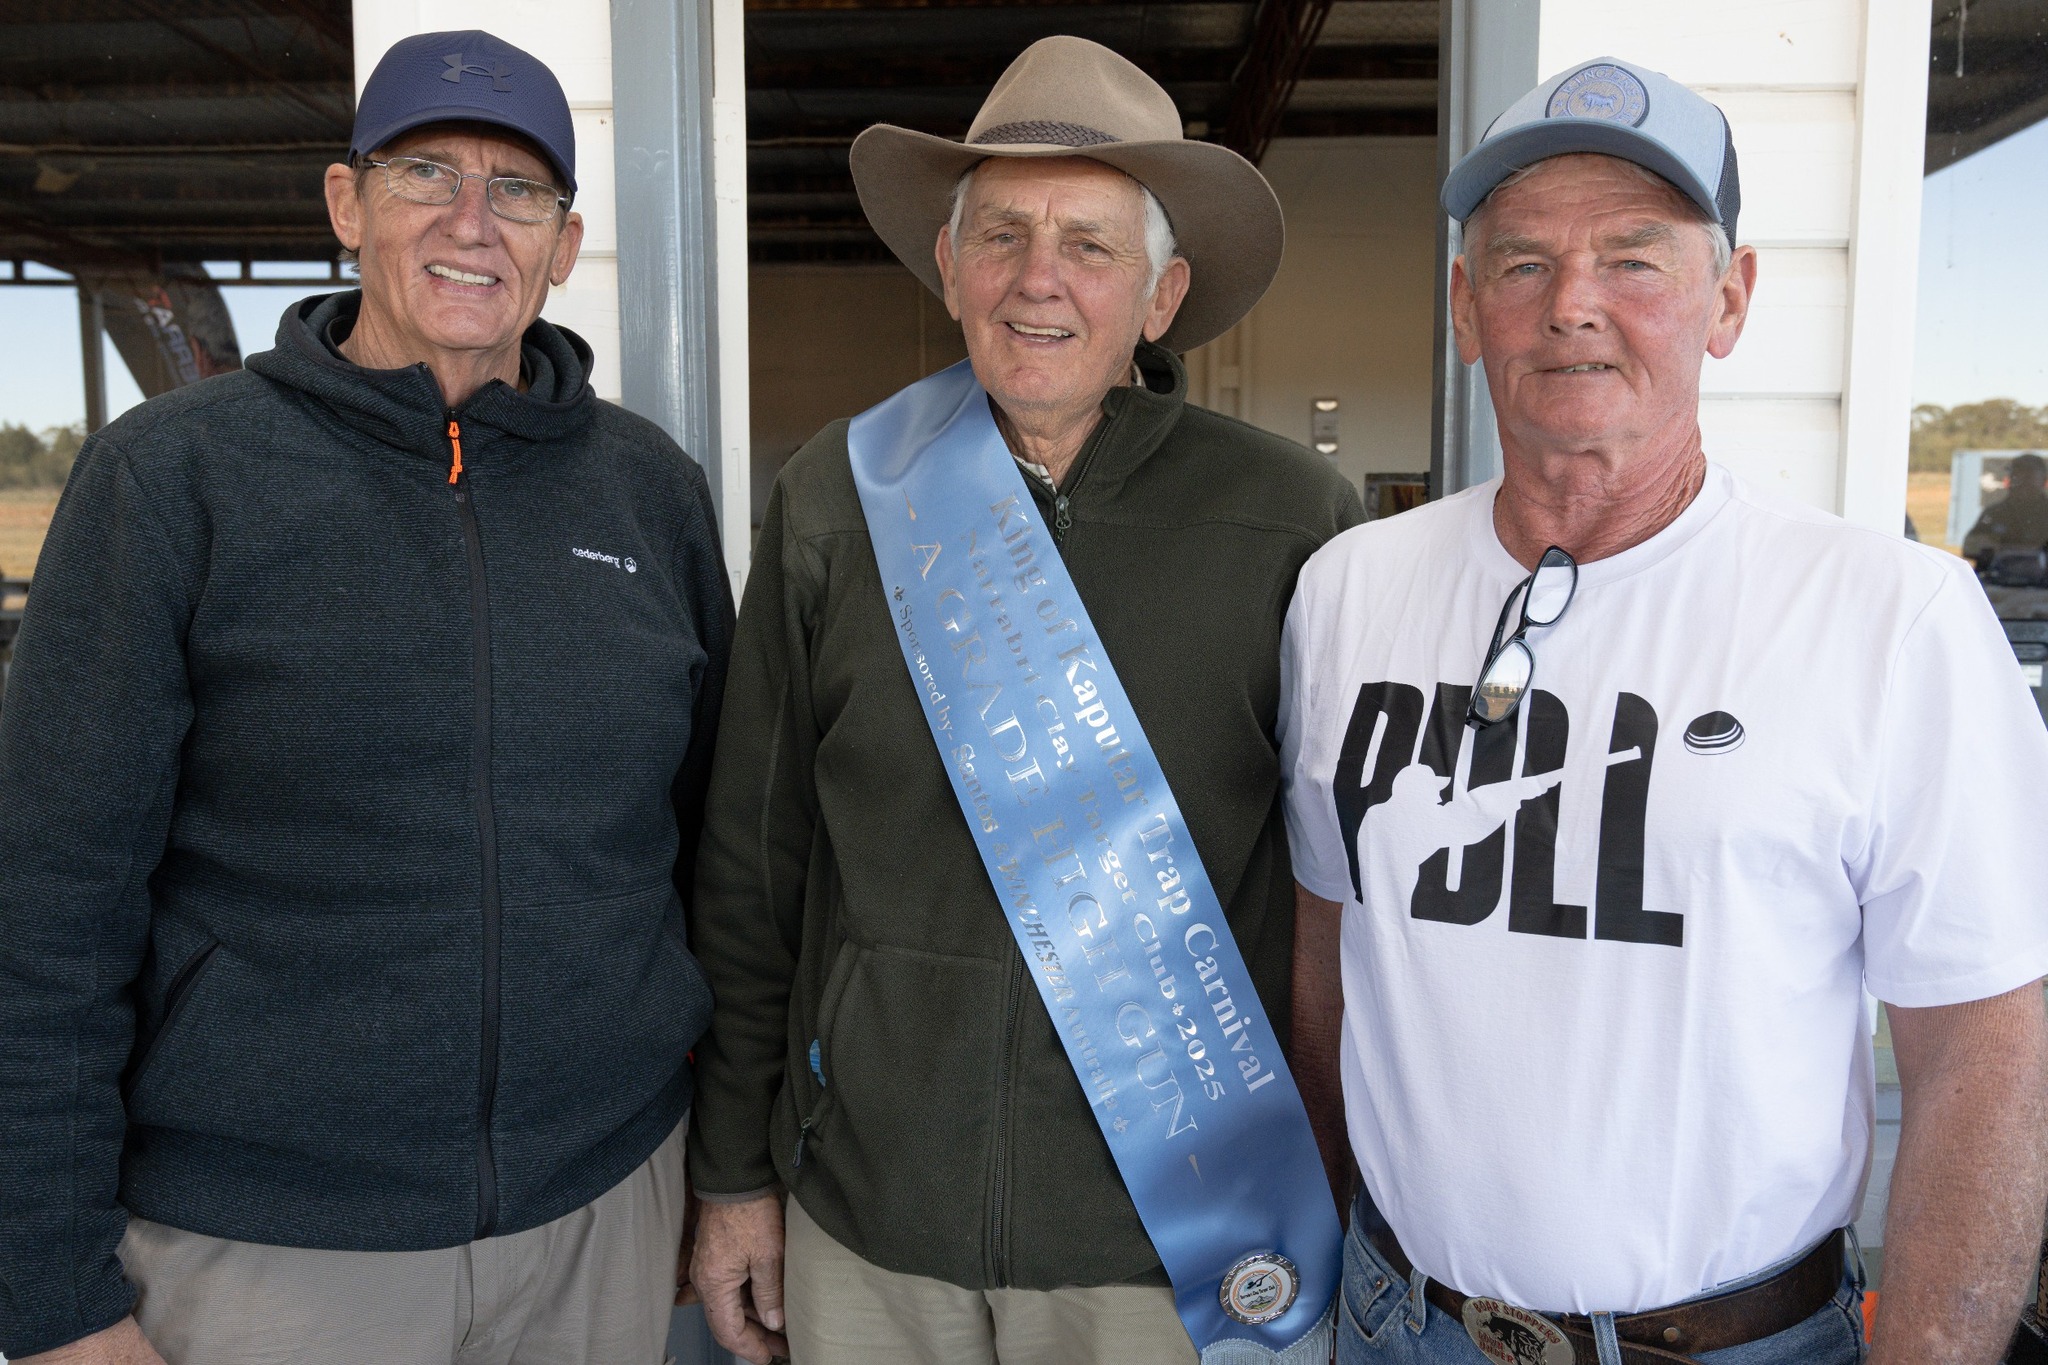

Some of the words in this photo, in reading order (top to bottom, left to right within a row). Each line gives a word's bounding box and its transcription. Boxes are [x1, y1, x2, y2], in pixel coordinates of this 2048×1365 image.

[573, 548, 620, 568] cederberg
[990, 491, 1046, 594] King
[1036, 599, 1078, 638] of
[1057, 638, 1150, 806] Kaputar
[1138, 812, 1191, 915] Trap
[1184, 922, 1276, 1094] Carnival
[900, 603, 947, 706] Sponsored
[950, 742, 998, 834] Santos
[997, 854, 1076, 1002] WINCHESTER
[1062, 1003, 1118, 1110] Australia
[911, 540, 942, 581] A
[934, 587, 1049, 808] GRADE
[1030, 814, 1132, 992] HIGH
[1115, 1000, 1199, 1140] GUN
[960, 530, 1042, 687] Narrabri
[1036, 695, 1080, 774] Clay
[1076, 780, 1138, 904] Target
[1133, 912, 1176, 999] Club
[1175, 1017, 1226, 1101] 2025
[1333, 681, 1684, 947] PULL
[1473, 1301, 1499, 1313] BOAR
[1503, 1304, 1561, 1344] STOPPERS
